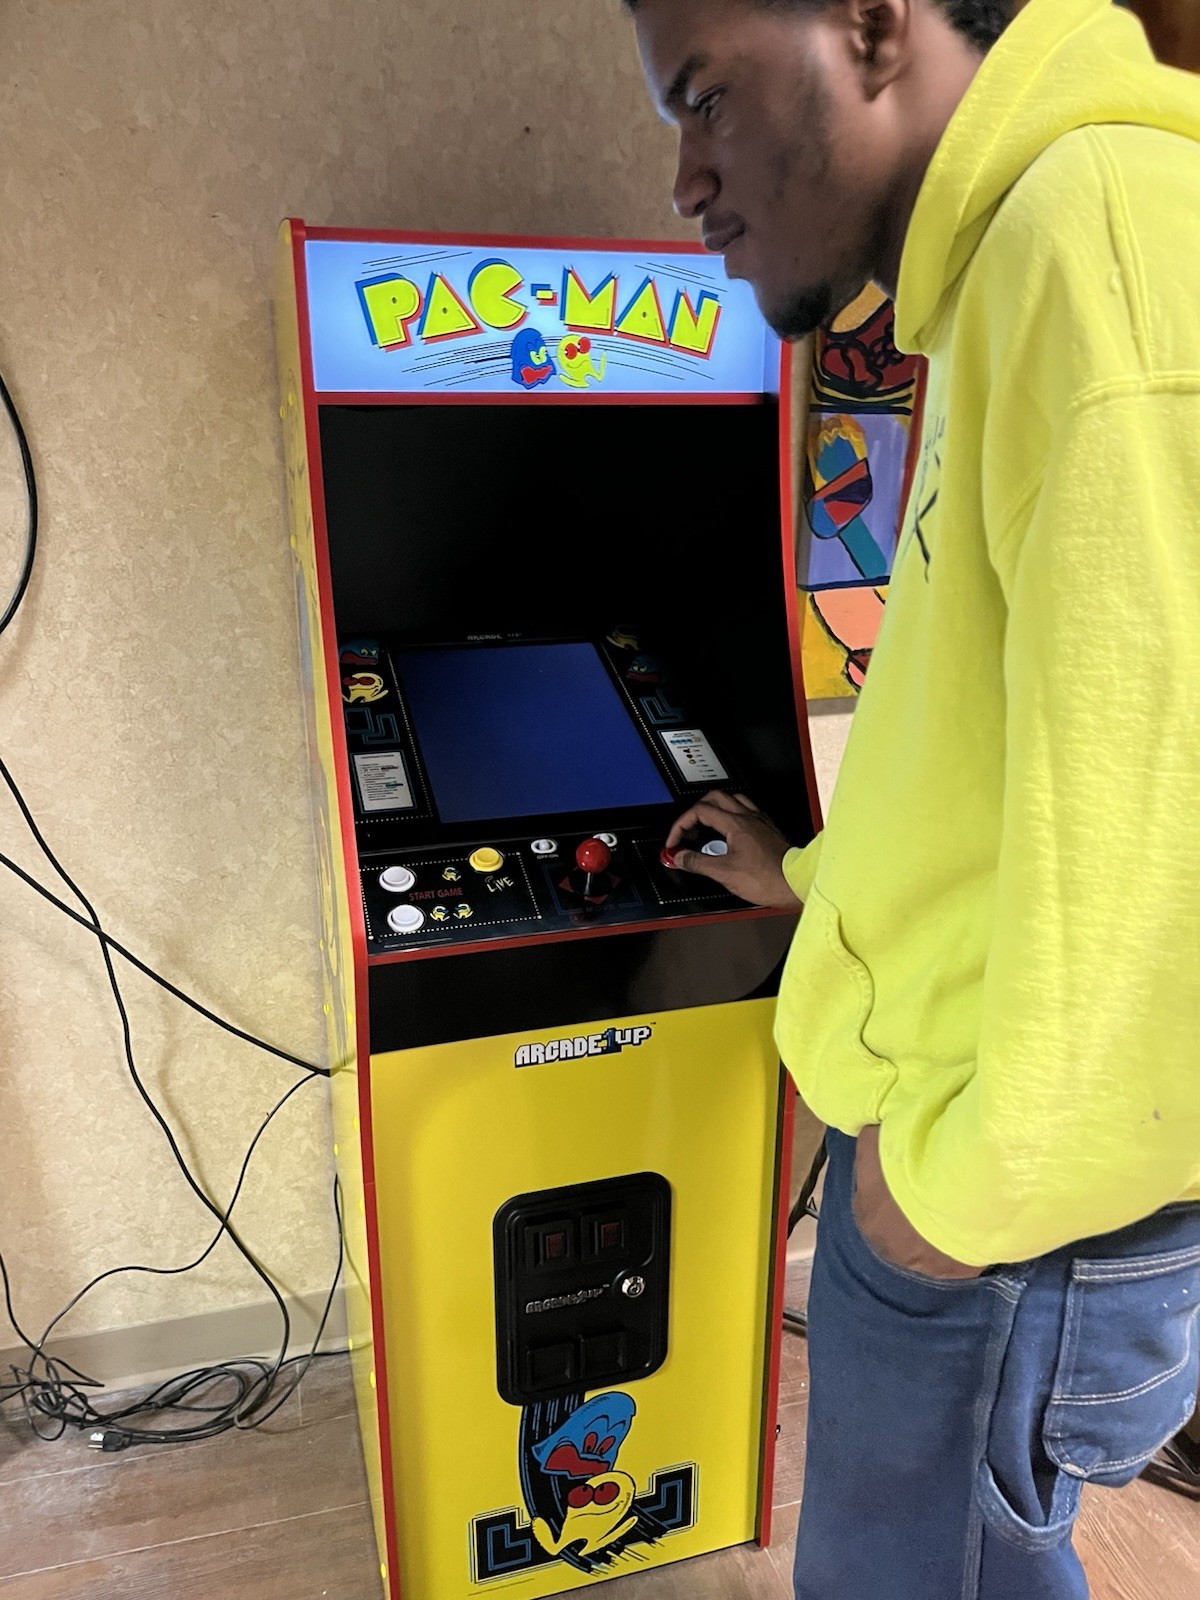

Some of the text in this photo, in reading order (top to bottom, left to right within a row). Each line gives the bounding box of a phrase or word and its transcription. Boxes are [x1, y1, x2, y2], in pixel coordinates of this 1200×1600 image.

[355, 258, 722, 359] PAC-MAN
[487, 876, 514, 892] LIVE
[409, 887, 463, 902] START GAME
